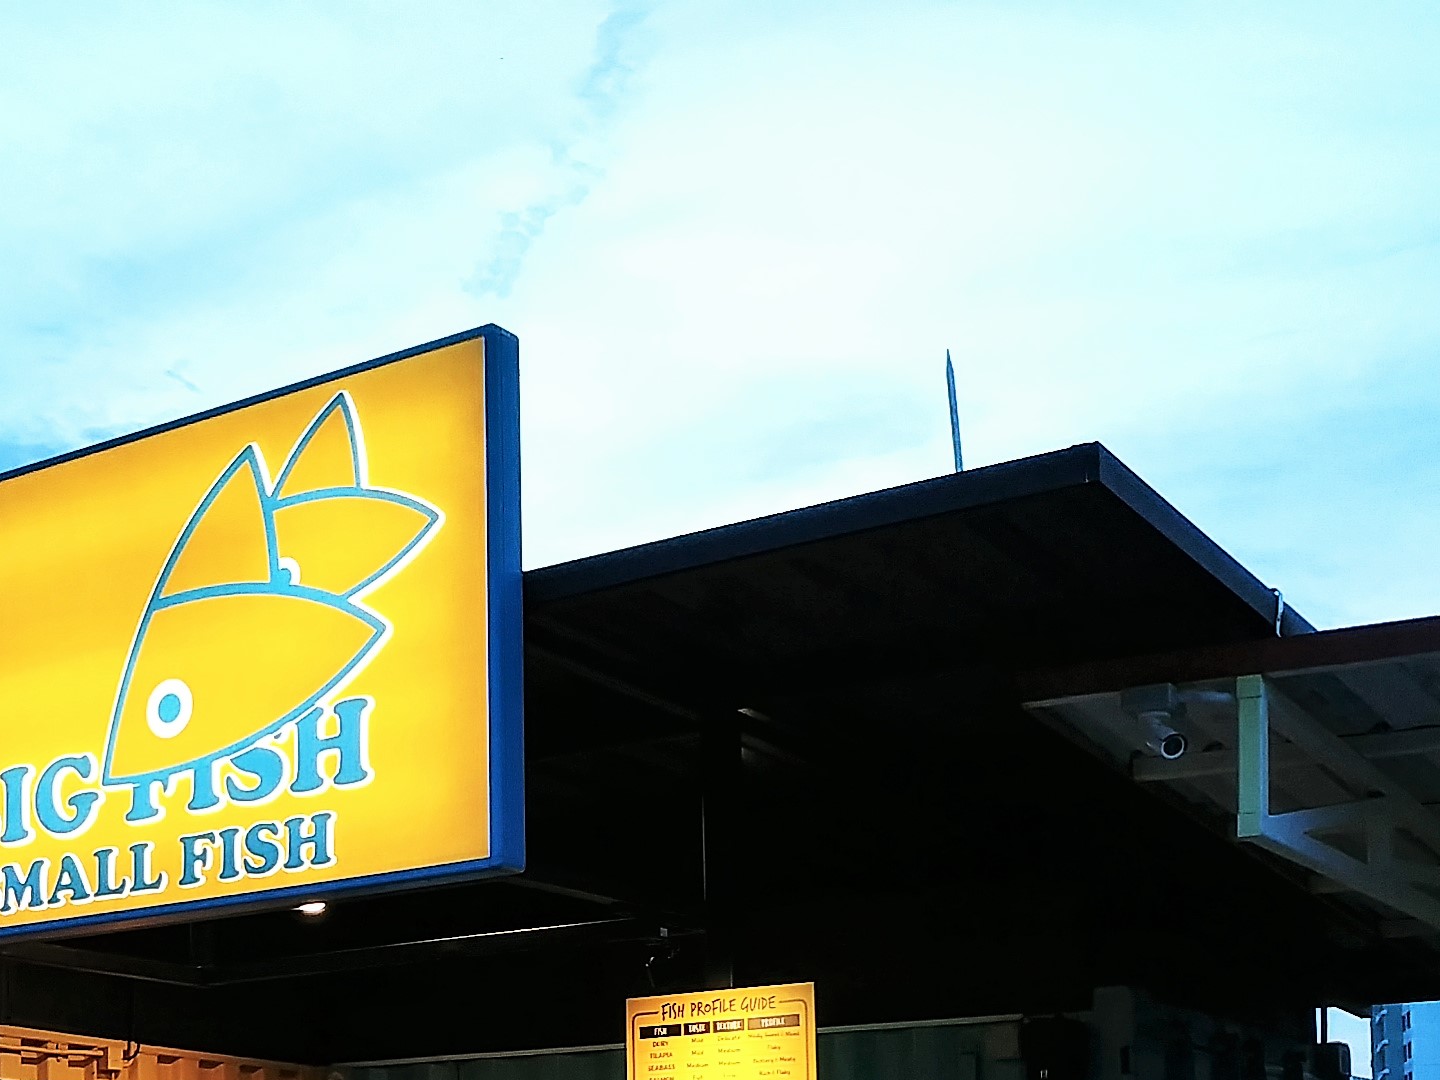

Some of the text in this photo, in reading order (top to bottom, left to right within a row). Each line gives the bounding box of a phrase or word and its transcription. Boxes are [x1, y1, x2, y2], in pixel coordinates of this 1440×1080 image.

[179, 813, 333, 886] FISH
[661, 995, 776, 1021] FISH PROFILE GUIDE
